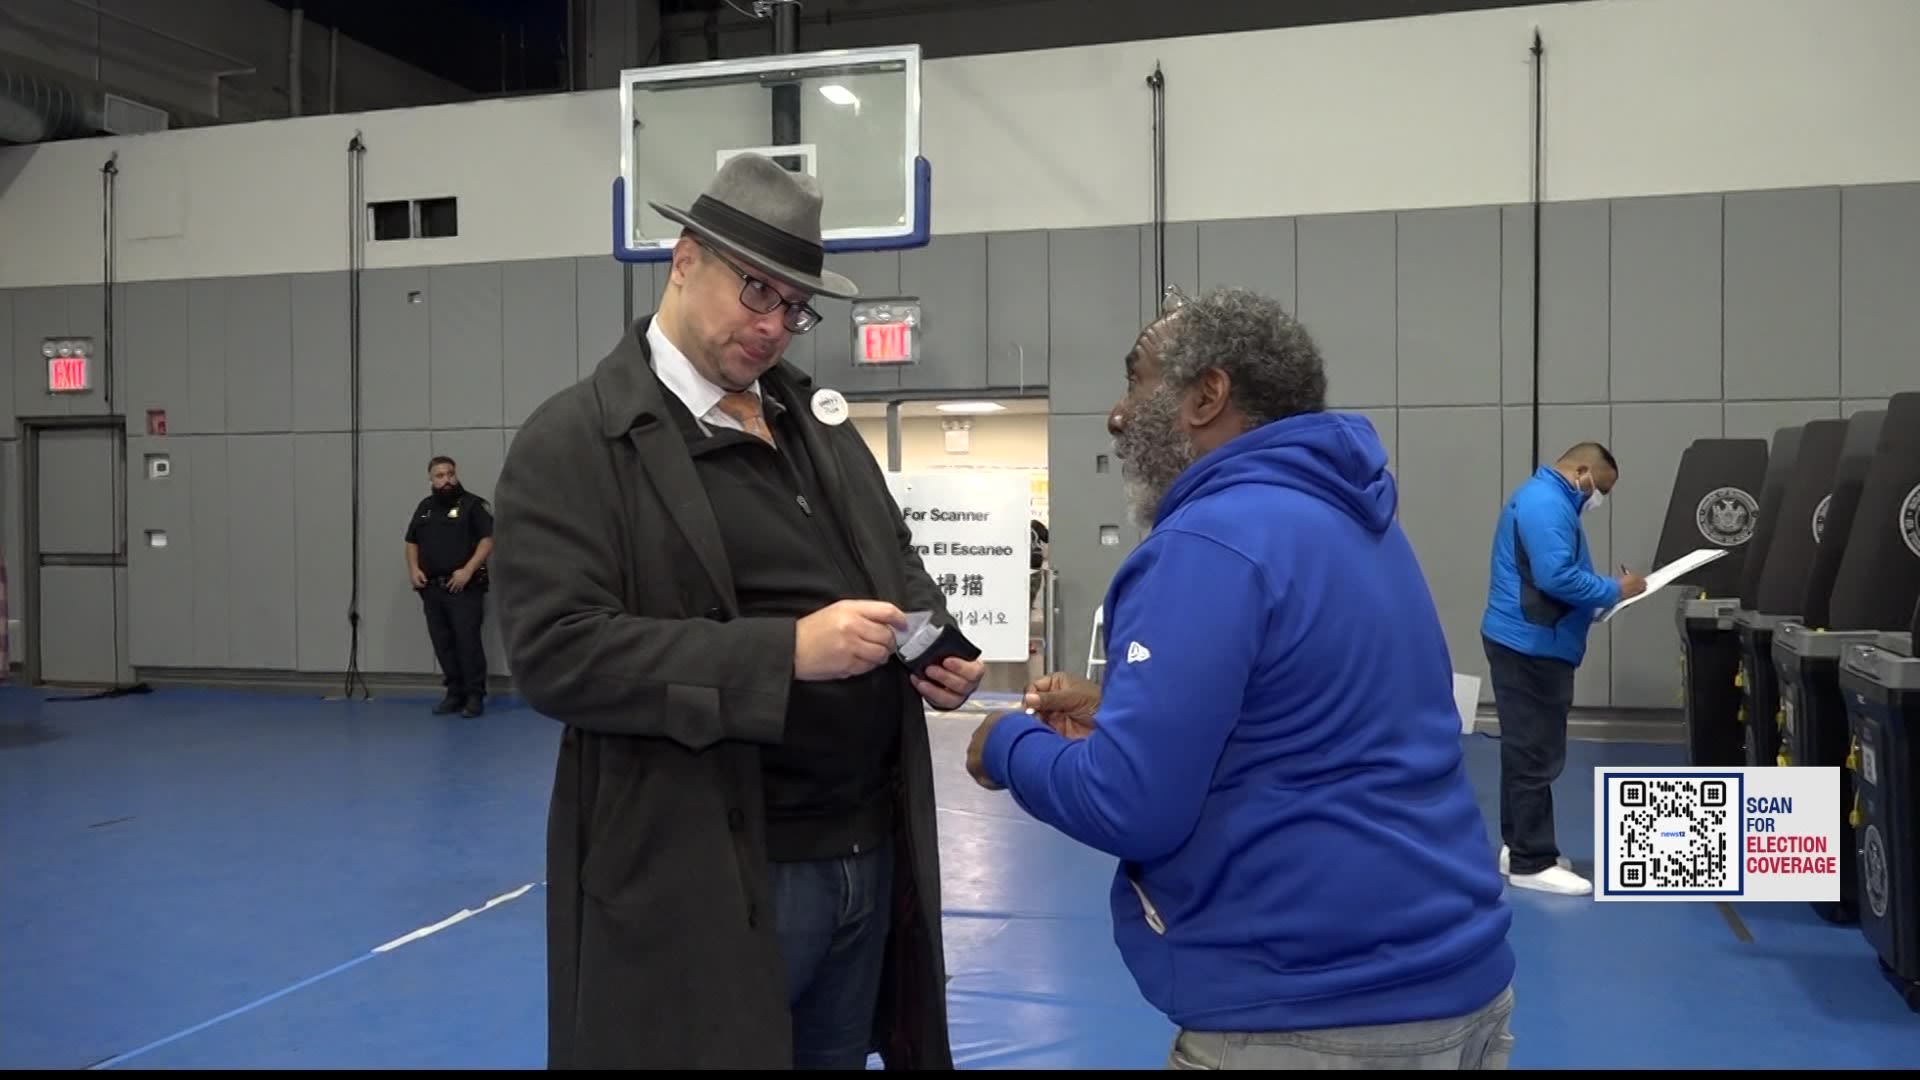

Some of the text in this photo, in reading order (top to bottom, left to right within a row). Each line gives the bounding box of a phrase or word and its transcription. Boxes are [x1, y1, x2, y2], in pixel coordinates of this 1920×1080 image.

[866, 326, 908, 358] EXIT
[54, 359, 83, 386] EXIT
[903, 507, 991, 521] For Scanner
[933, 542, 947, 555] El
[950, 542, 1013, 555] Escaneo
